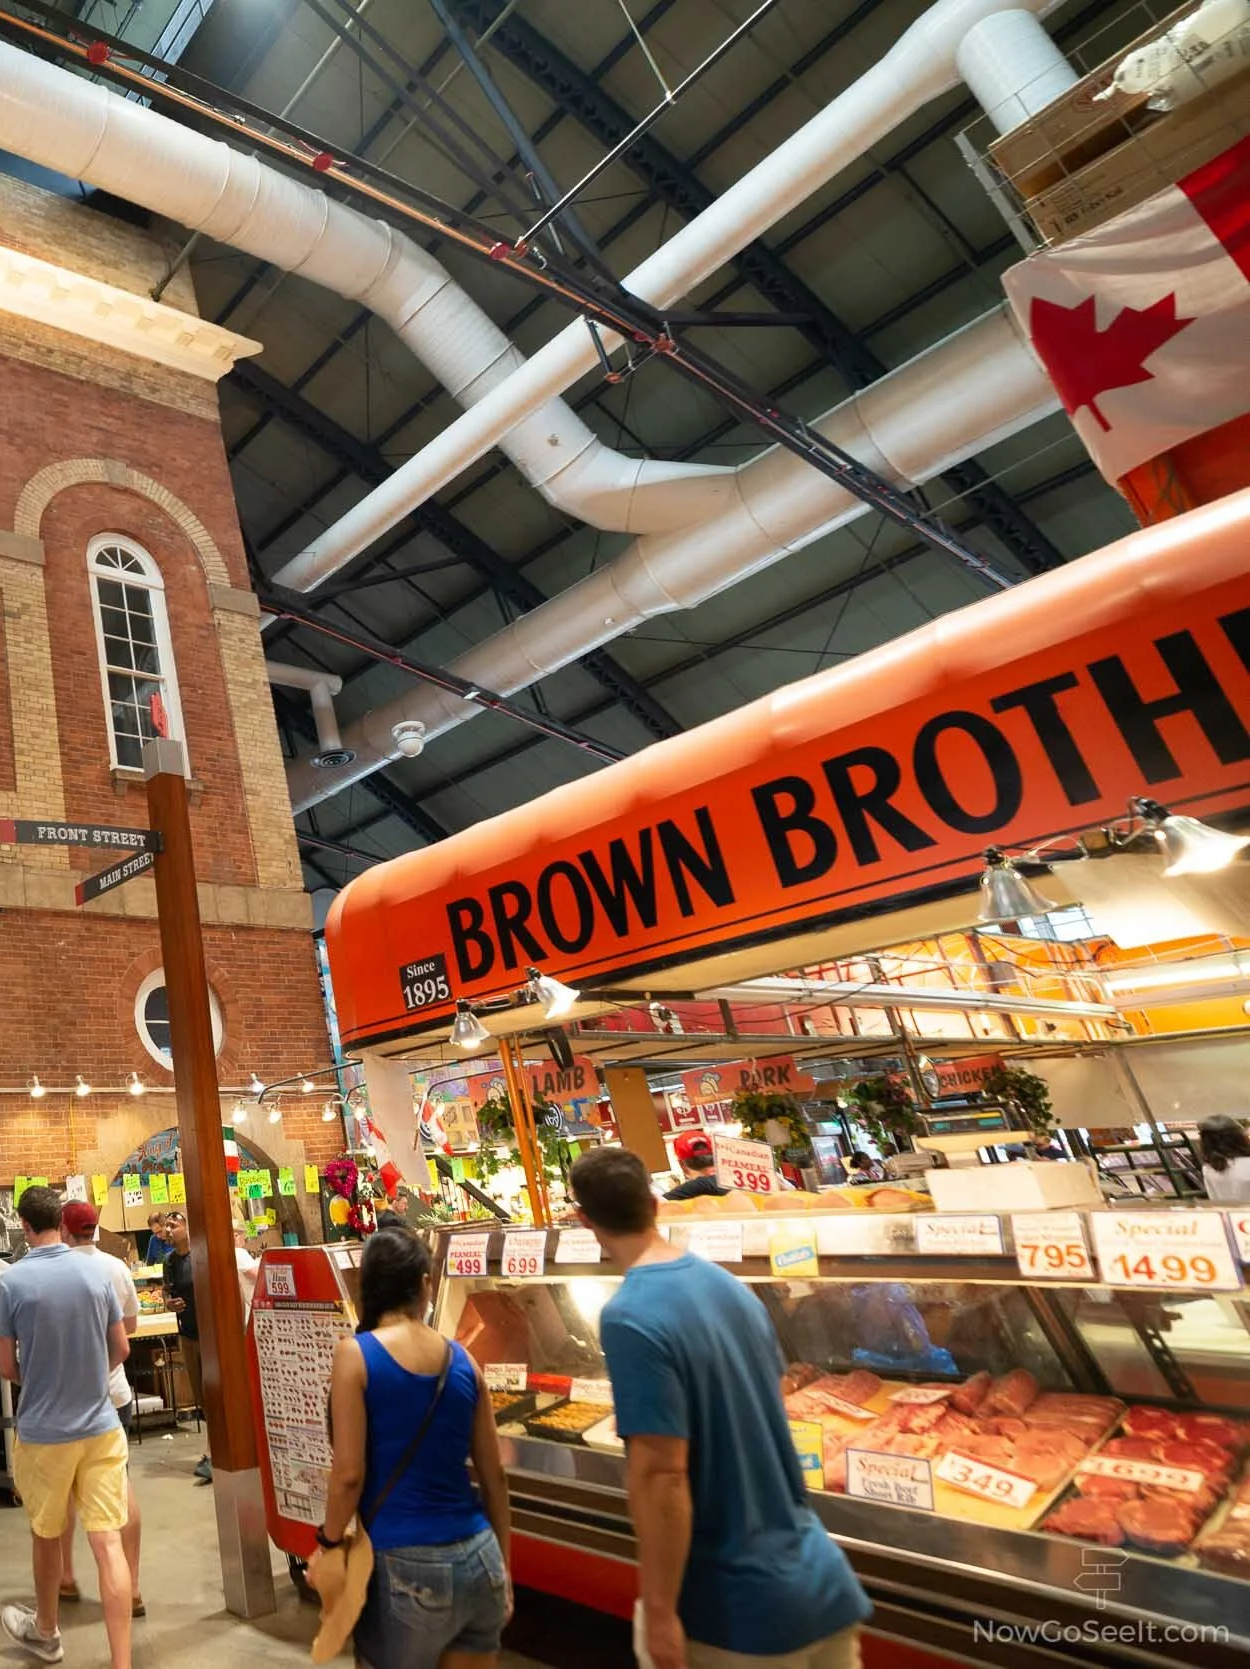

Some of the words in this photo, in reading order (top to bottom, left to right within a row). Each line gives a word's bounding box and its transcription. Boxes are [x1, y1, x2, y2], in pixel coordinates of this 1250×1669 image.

[445, 806, 736, 984] BROWN
[750, 607, 1250, 889] BROTH
[37, 826, 88, 841] FRONT
[93, 830, 146, 847] STREET
[99, 868, 122, 890] MAIN
[123, 852, 154, 876] STREET
[406, 960, 435, 979] Since
[403, 975, 449, 1009] 1895
[532, 1066, 585, 1098] LAMB
[1116, 1219, 1198, 1239] Special
[856, 1458, 929, 1484] Special
